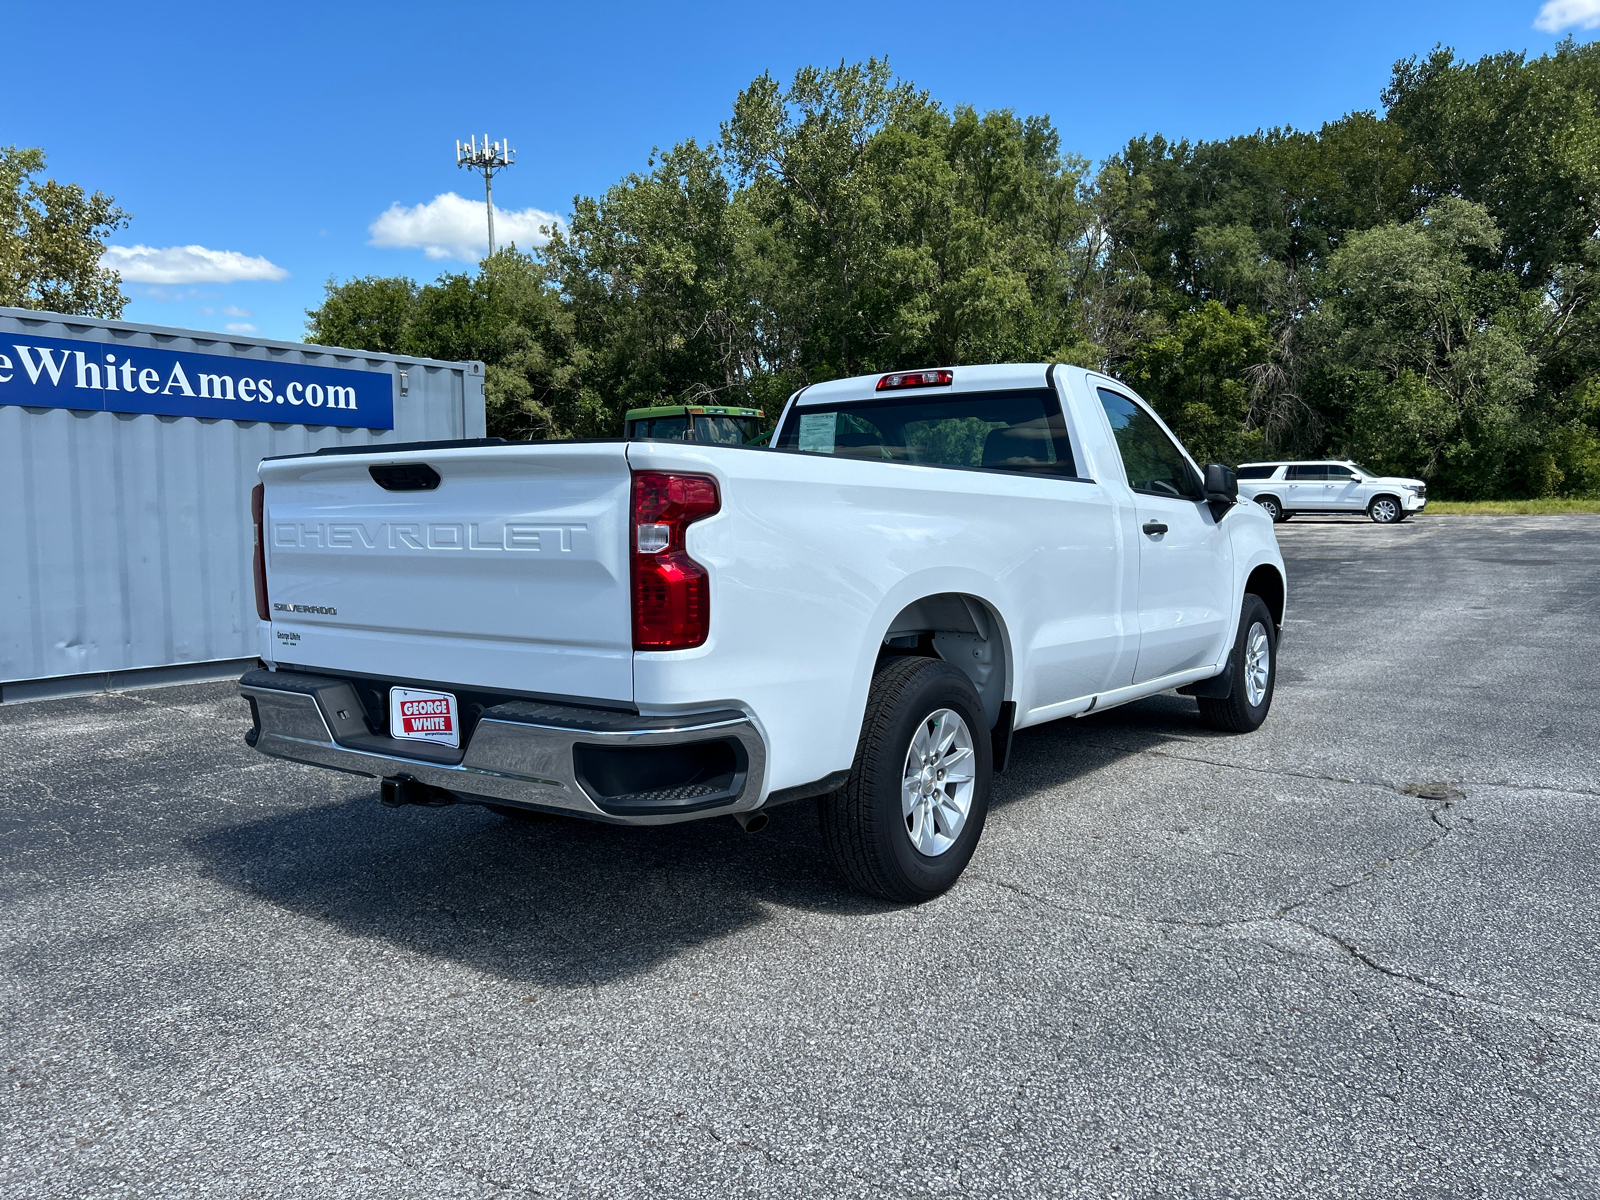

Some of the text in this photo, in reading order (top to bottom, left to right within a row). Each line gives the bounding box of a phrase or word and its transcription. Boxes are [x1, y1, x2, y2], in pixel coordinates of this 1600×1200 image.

[274, 523, 587, 552] CHEVROLET
[273, 603, 337, 615] SILVERADO
[403, 701, 447, 715] GEORGE
[411, 718, 445, 731] WHITE
